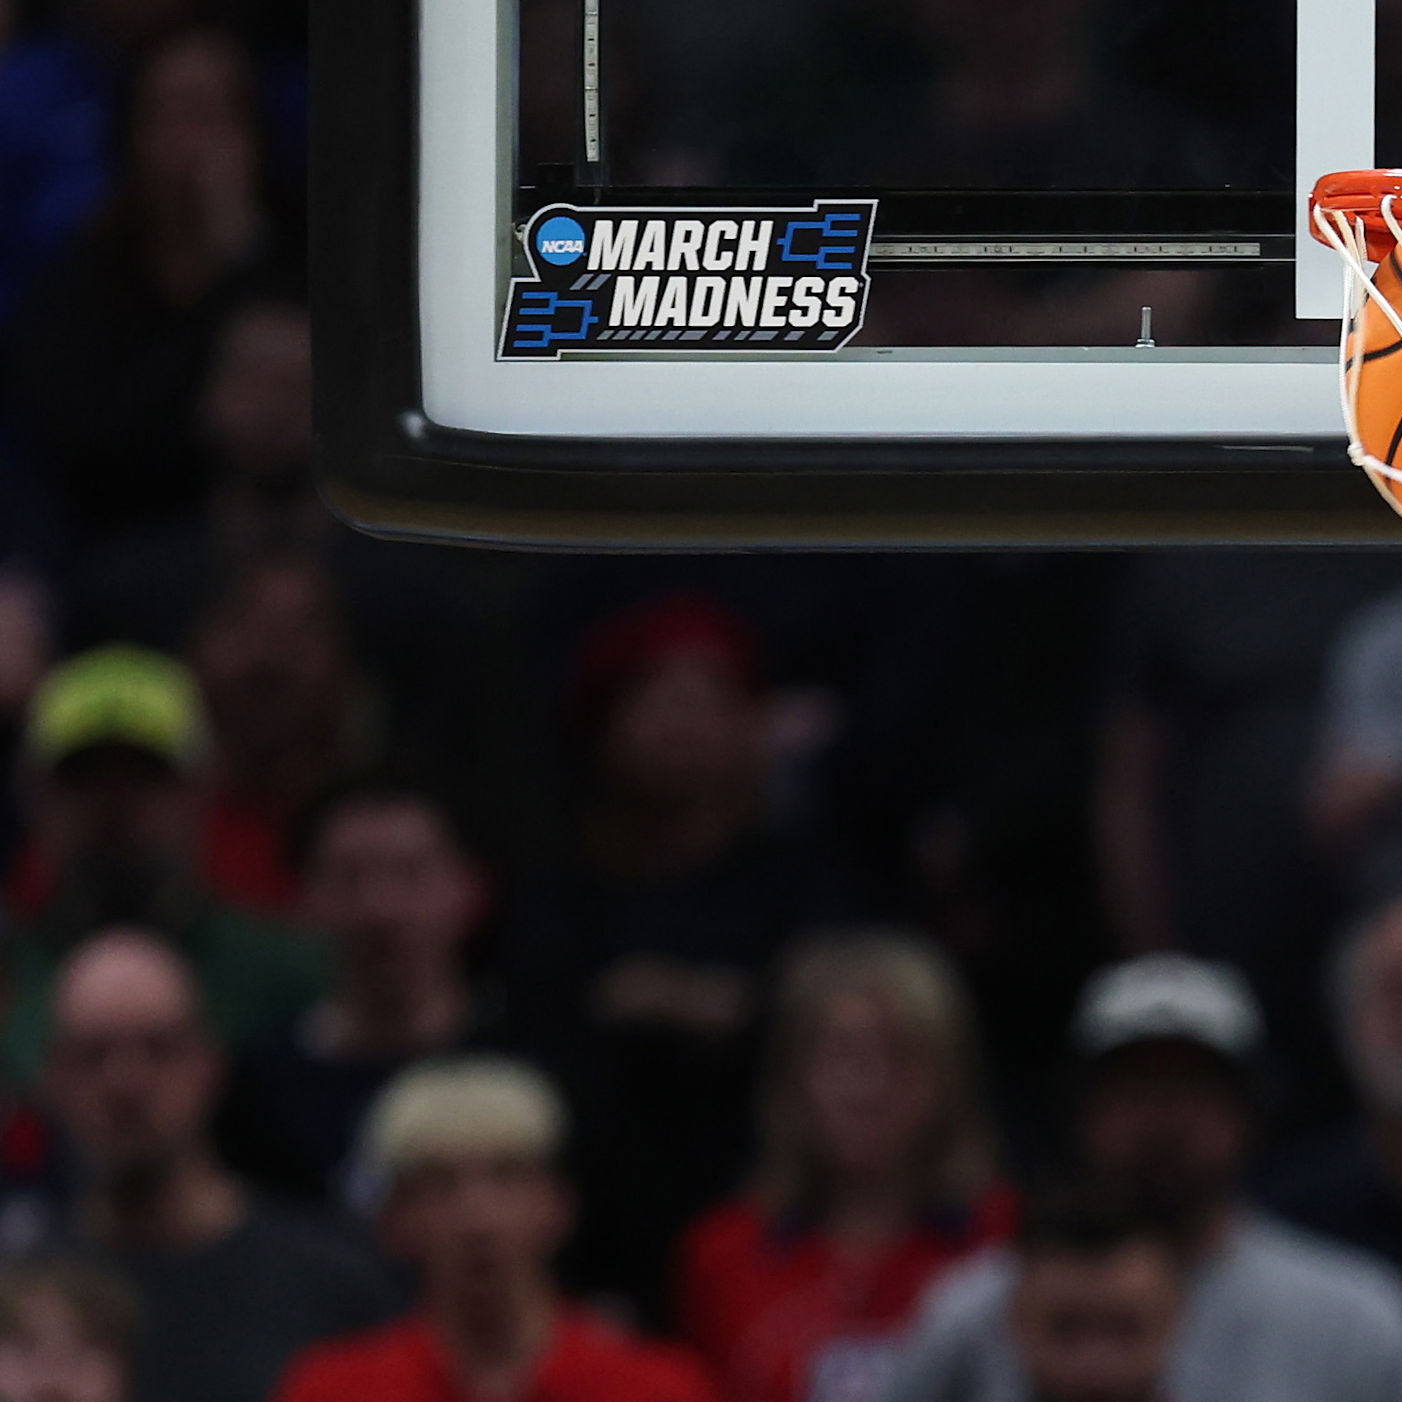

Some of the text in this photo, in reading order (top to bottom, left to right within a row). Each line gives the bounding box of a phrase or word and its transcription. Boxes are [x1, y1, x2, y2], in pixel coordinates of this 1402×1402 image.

[541, 239, 585, 254] NCAA
[586, 219, 774, 271] MARCH
[608, 276, 861, 328] MADNESS
